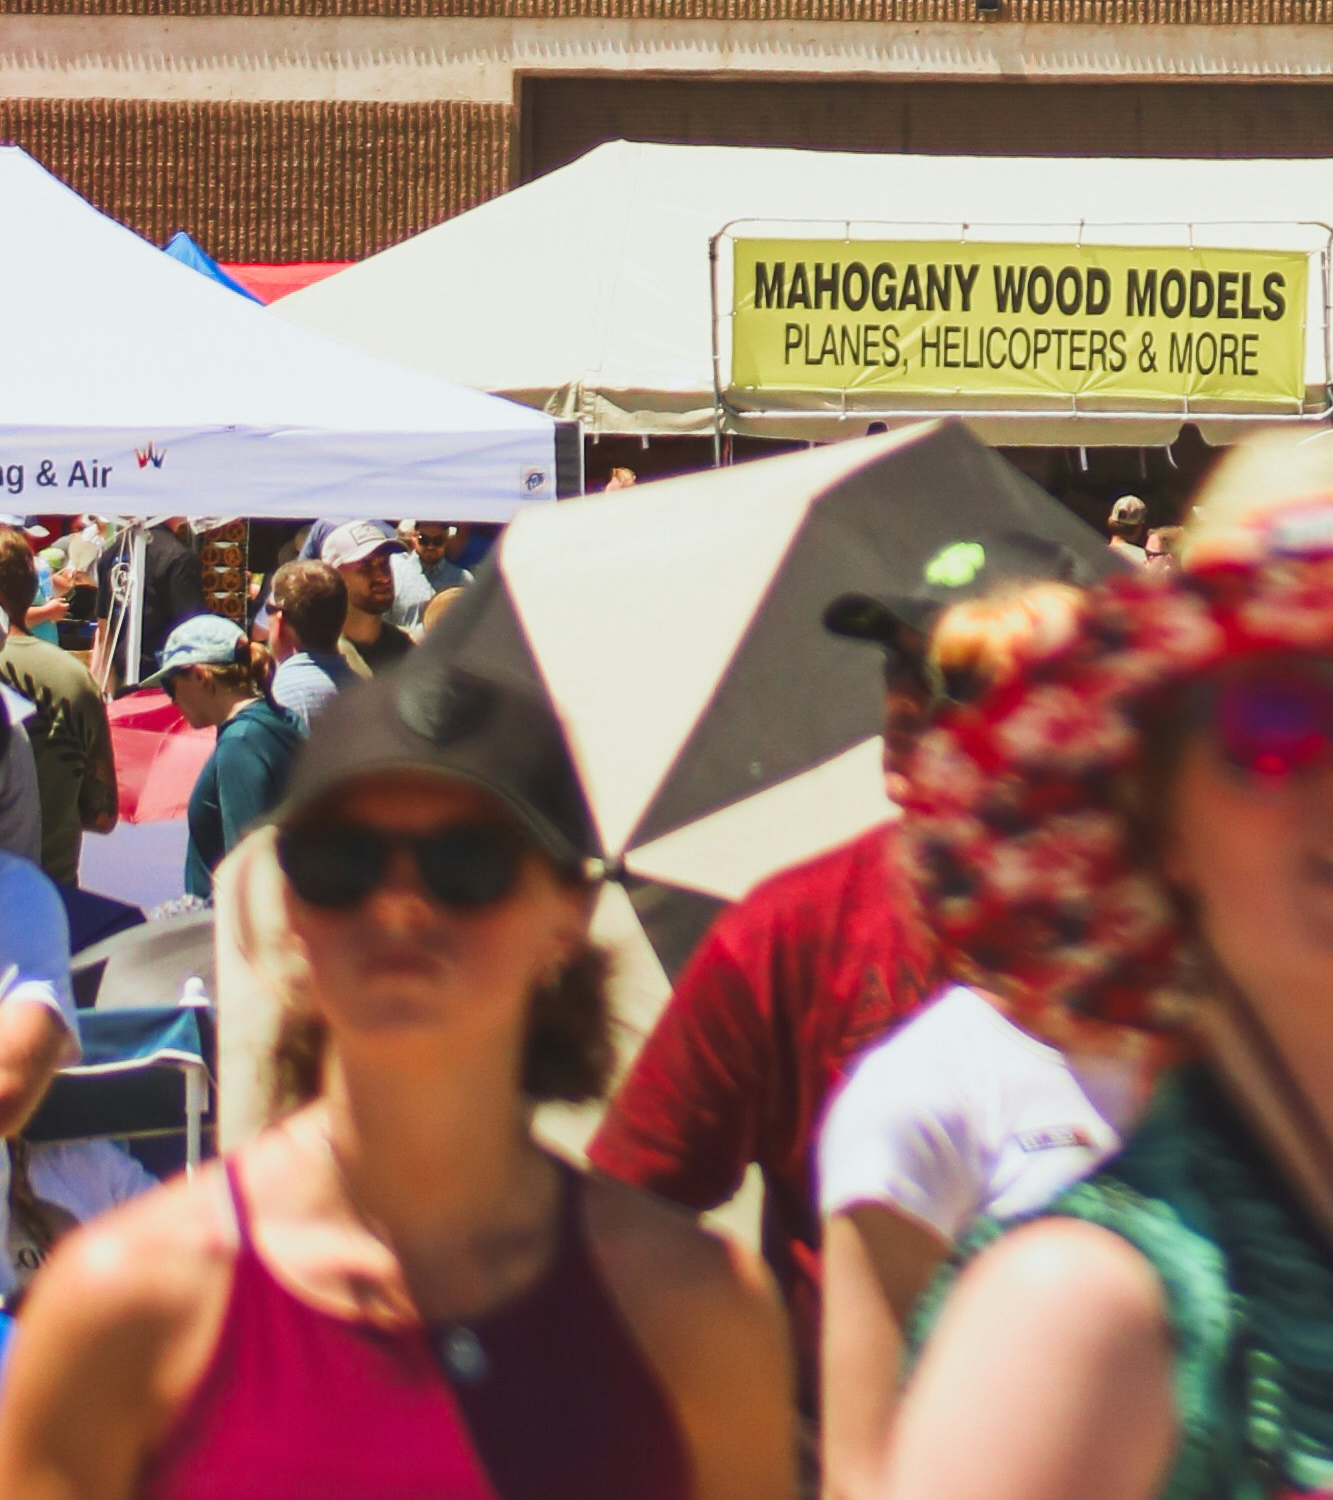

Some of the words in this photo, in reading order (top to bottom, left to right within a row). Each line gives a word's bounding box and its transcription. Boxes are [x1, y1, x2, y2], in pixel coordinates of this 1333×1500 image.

[754, 260, 980, 314] MAHOGANY
[992, 263, 1112, 316] WOOD
[1126, 266, 1286, 322] MODELS
[784, 321, 909, 370] PLANES,
[920, 324, 1127, 373] HELICOPTERS
[1140, 330, 1158, 371] &
[1168, 331, 1259, 377] MORE
[0, 464, 25, 494] g
[36, 459, 58, 487] &
[66, 459, 113, 488] Air
